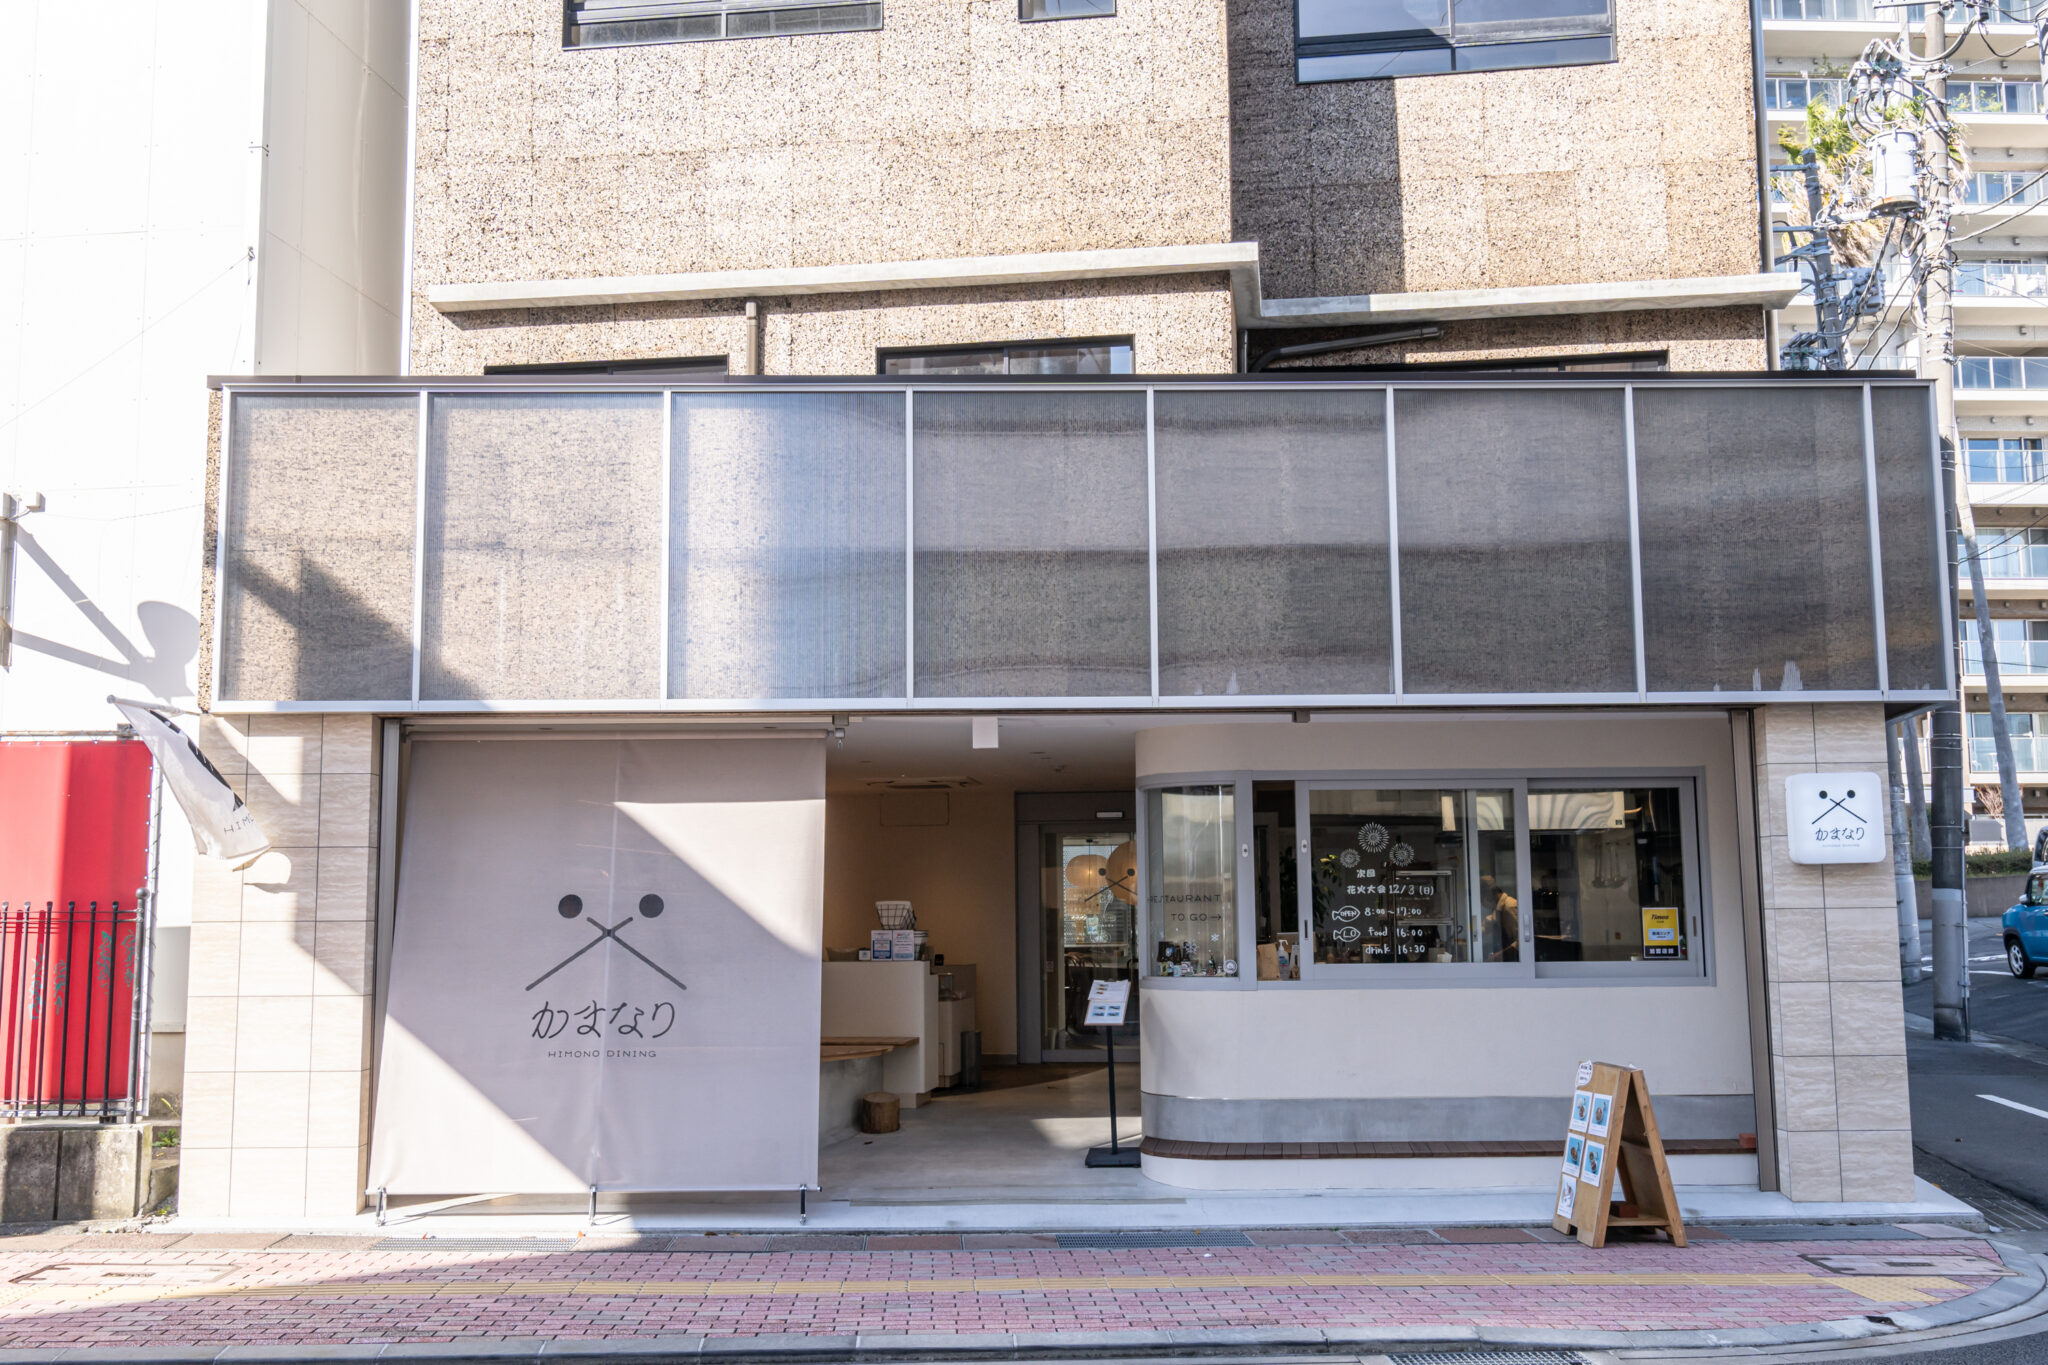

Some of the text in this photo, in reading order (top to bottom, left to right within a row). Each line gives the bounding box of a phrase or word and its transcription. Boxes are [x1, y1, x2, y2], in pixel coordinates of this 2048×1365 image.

[1815, 827, 1865, 841] かまなり
[1347, 884, 1386, 895] 花火大会
[1171, 913, 1208, 921] TO GO
[1368, 926, 1423, 937] food 16:00
[1365, 944, 1426, 955] drink 16:30
[532, 1000, 676, 1039] かまなり
[548, 1050, 657, 1058] HIMONO DINING
